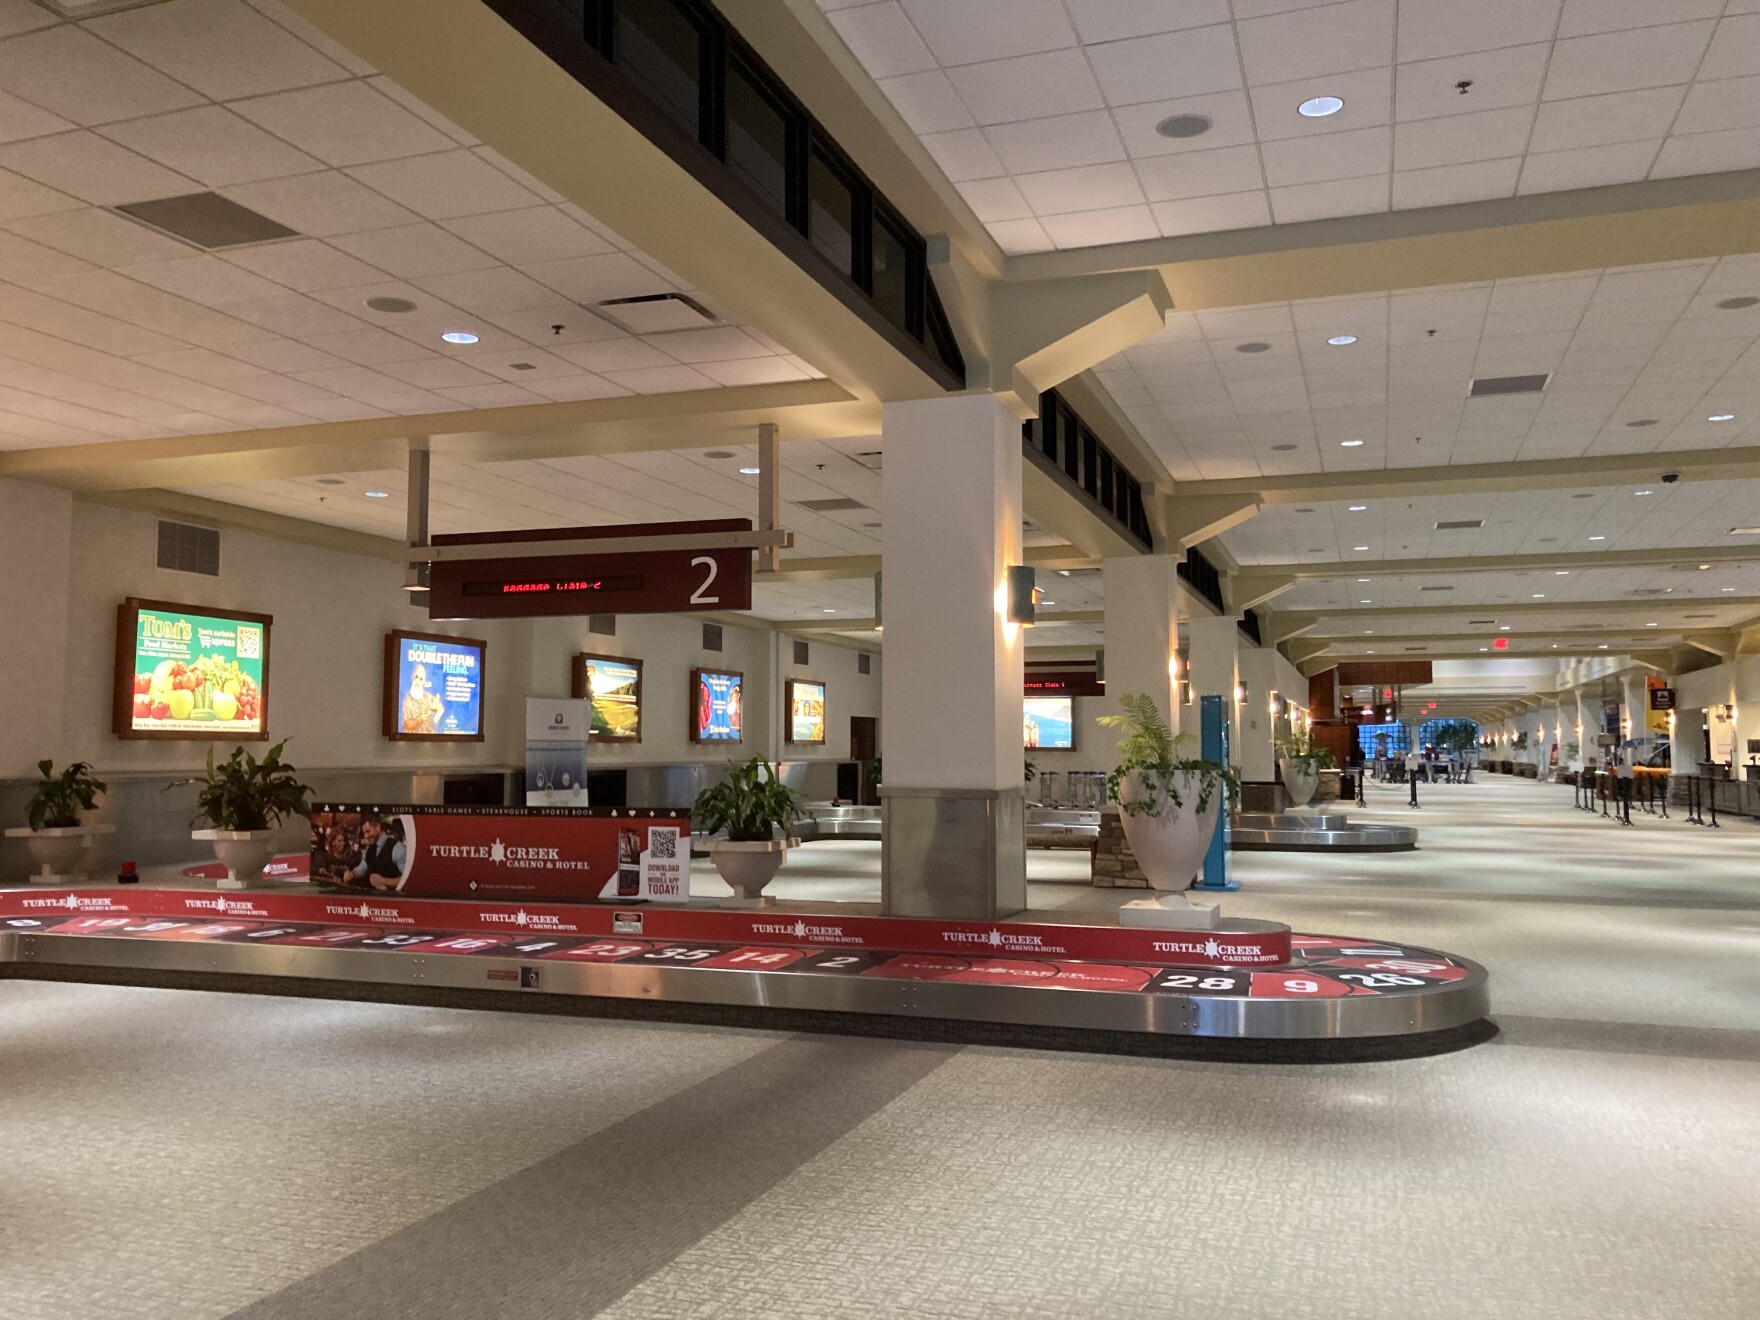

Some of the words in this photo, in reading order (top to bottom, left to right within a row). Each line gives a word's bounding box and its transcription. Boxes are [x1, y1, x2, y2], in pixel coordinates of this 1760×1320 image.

[689, 556, 720, 605] 2
[144, 640, 160, 648] Food
[161, 641, 187, 650] Markets
[408, 650, 443, 665] DOUBLE
[443, 653, 457, 666] THE
[458, 655, 474, 668] FUN
[430, 845, 488, 858] TURTLE
[507, 847, 560, 860] CREEK
[547, 861, 553, 869] &
[556, 862, 590, 870] HOTEL
[647, 864, 680, 872] DOWNLOAD
[648, 884, 679, 895] TODAY!
[22, 899, 67, 907] TURTLE
[77, 898, 112, 906] CREEK
[185, 899, 218, 909] TURTLE
[225, 901, 253, 909] CREEK
[326, 906, 360, 915] TURTLE
[369, 908, 399, 917] CREEK
[480, 914, 516, 923] TURTLE
[526, 915, 559, 924] CREEK
[752, 924, 794, 934] TURTLE
[805, 926, 843, 936] CREEK
[942, 932, 988, 943] TURTLE
[1001, 934, 1042, 944] CREEK
[516, 942, 559, 952] 4
[567, 944, 642, 956] 23
[1152, 942, 1205, 953] TURTLE
[1218, 945, 1261, 955] CREEK
[644, 948, 720, 960] 35
[729, 951, 790, 964] 14
[1259, 954, 1279, 962] HOTEL
[816, 956, 860, 967] 2
[1160, 975, 1236, 990] 28
[1283, 979, 1319, 993] 9
[1339, 973, 1425, 987] 26
